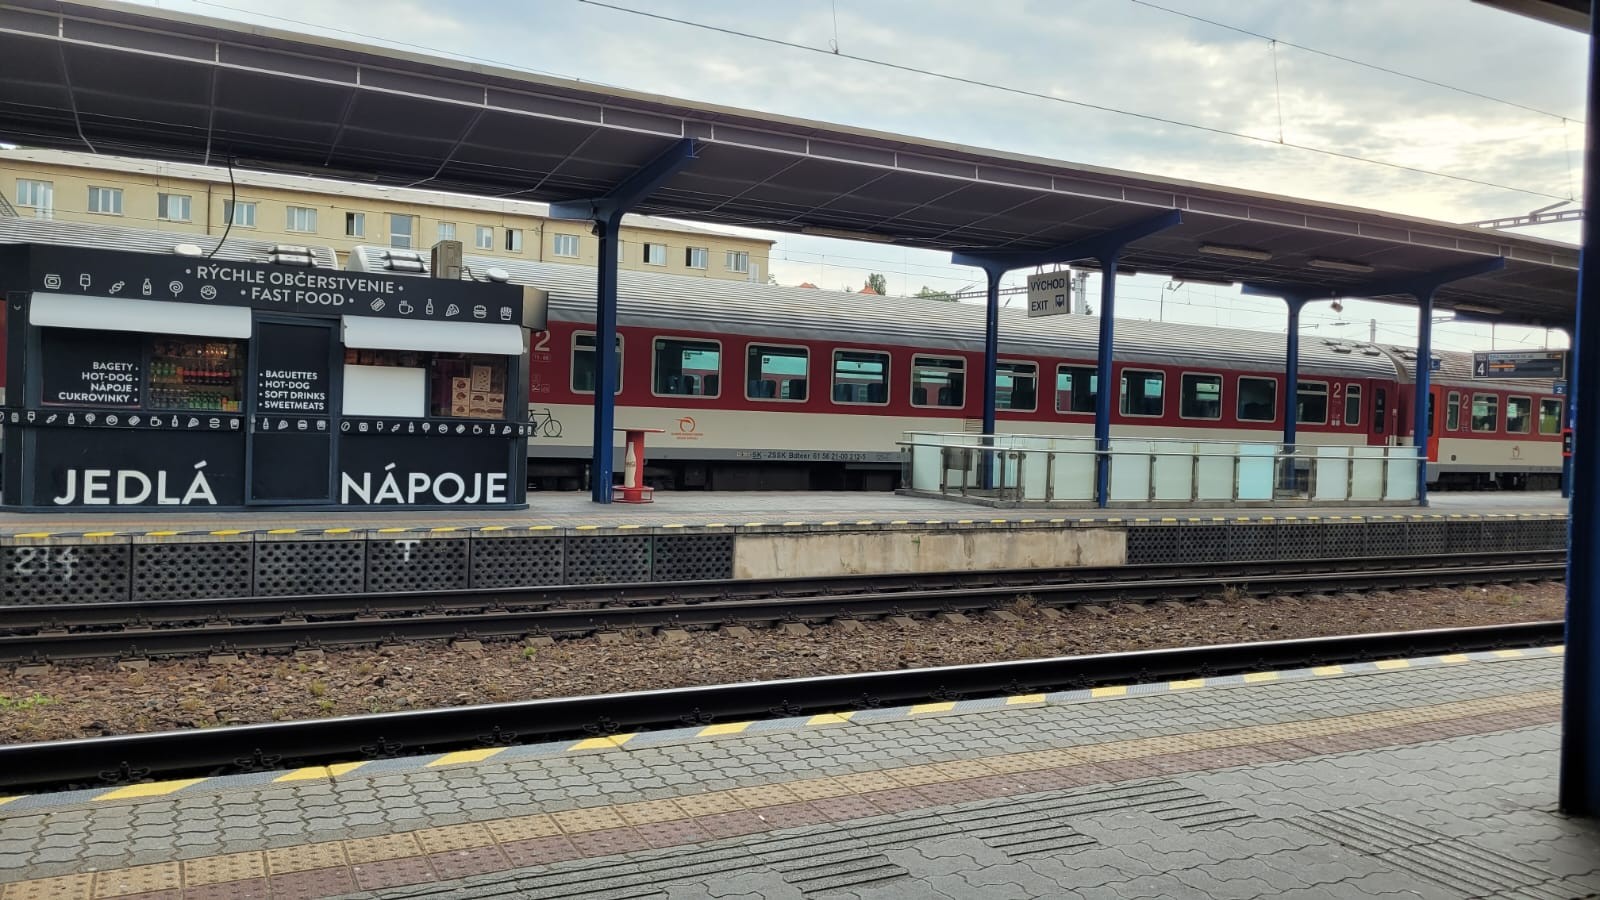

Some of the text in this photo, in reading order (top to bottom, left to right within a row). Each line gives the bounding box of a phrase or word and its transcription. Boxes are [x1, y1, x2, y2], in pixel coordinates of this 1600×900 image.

[197, 263, 395, 294] RÝCHLE OBČERSTVENIE
[1030, 278, 1065, 291] VÝCHOD
[251, 287, 344, 306] FAST FOOD
[1031, 300, 1048, 312] EXIT
[93, 362, 133, 371] BAGETY
[1477, 362, 1485, 376] 4
[82, 372, 133, 381] HOT-DOG
[265, 370, 318, 380] BAGUETTES
[90, 382, 132, 392] NÁPOJE
[265, 380, 310, 390] HOT-DOG
[1333, 382, 1341, 398] 2
[58, 391, 130, 403] CUKROVINKY
[264, 390, 325, 400] SOFT DRINKS
[264, 400, 324, 410] SWEETMEATS
[1462, 394, 1469, 410] 2
[54, 460, 218, 505] JEDLÁ
[341, 462, 508, 505] NÁPOJE
